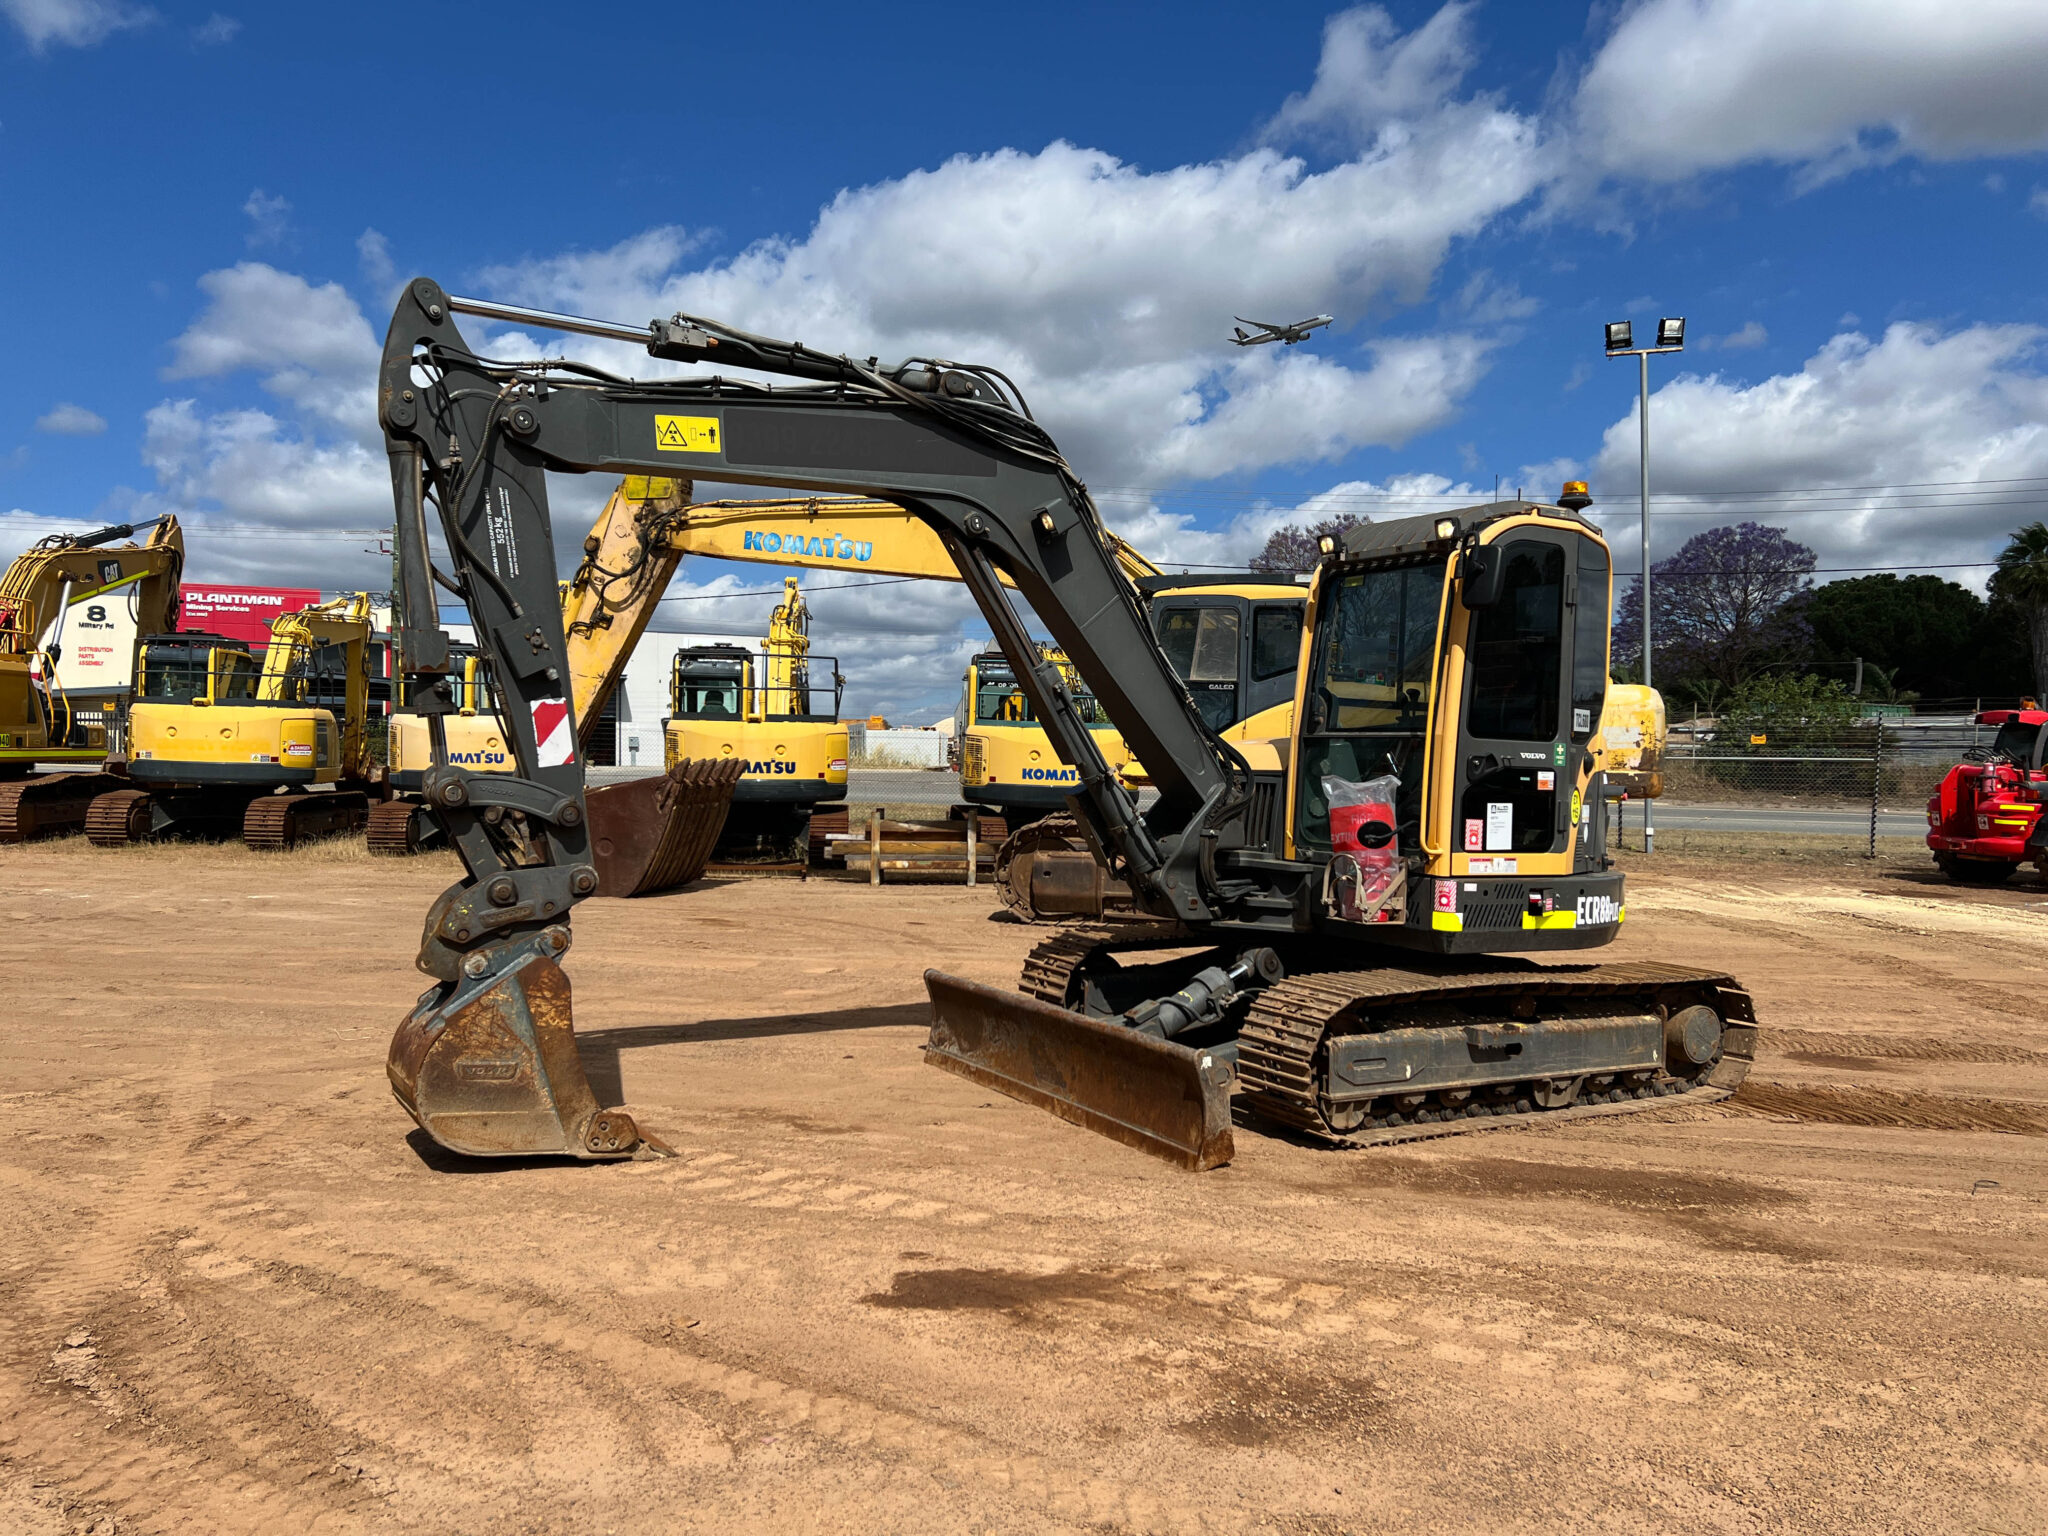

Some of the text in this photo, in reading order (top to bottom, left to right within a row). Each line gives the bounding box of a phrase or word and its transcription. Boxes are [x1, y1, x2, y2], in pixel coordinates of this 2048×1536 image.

[494, 516, 505, 544] 552 kg
[743, 529, 873, 562] KOMATSU
[104, 562, 119, 584] CAT
[186, 592, 283, 606] PLANTMAN
[87, 605, 107, 622] 8
[186, 603, 213, 612] Mining
[78, 622, 103, 630] Military
[0, 735, 9, 746] 40
[429, 750, 504, 764] MATSU
[1520, 752, 1546, 760] VOLVO
